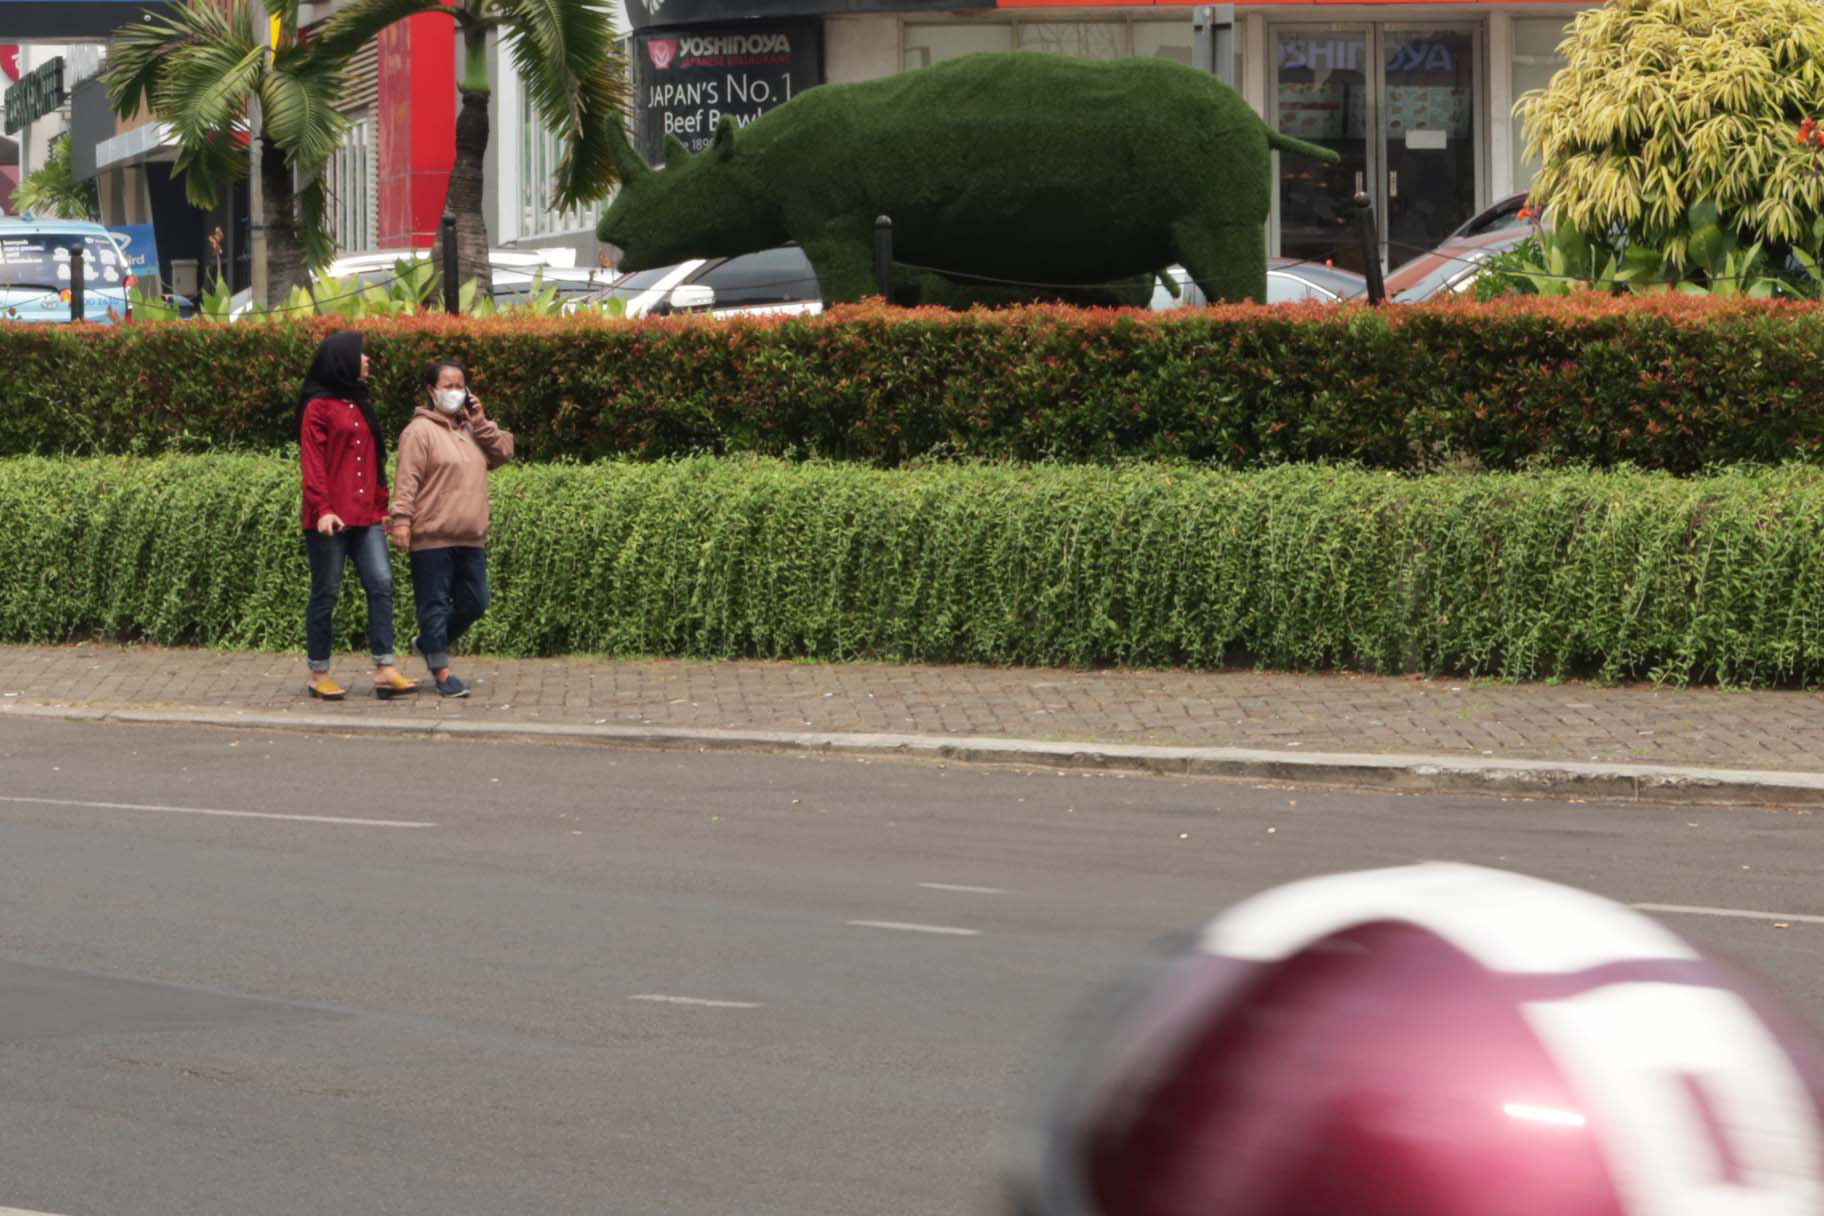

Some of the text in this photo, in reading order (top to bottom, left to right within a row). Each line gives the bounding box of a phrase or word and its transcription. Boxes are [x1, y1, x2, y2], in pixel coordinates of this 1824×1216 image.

[679, 34, 791, 57] YOSHINOYA
[648, 81, 719, 109] JAPAN'S
[664, 107, 764, 134] Beef Bwl
